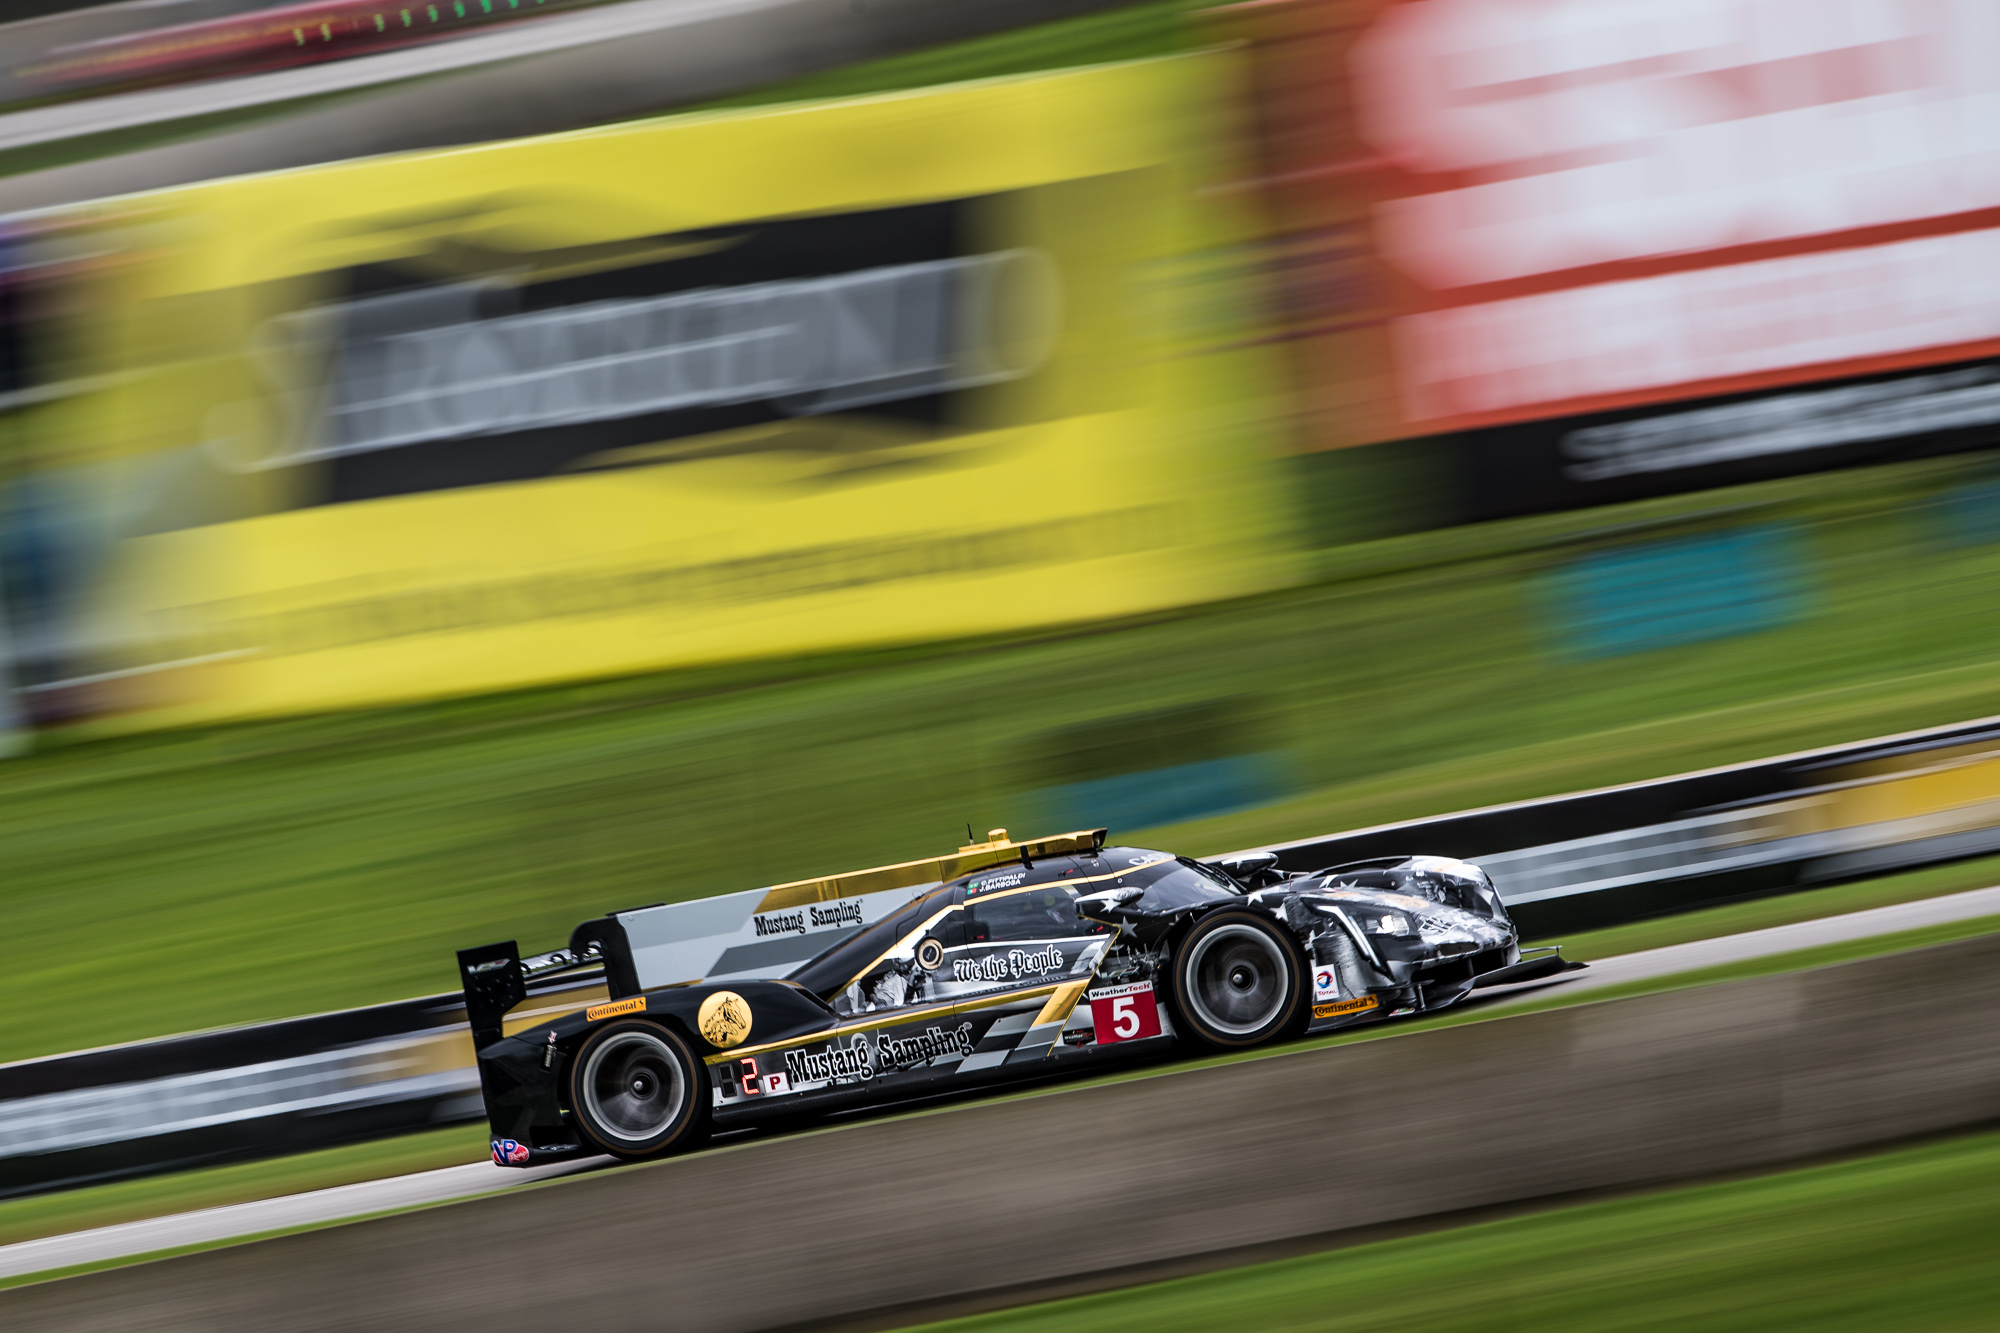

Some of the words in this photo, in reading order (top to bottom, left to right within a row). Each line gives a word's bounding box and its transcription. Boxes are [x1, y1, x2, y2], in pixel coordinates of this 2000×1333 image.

[753, 910, 806, 937] Mustang
[810, 900, 863, 928] Sampling
[953, 958, 982, 983] We
[981, 954, 1008, 981] the
[1008, 944, 1063, 978] People
[1092, 983, 1151, 997] WeatherTech
[588, 1000, 637, 1020] Continental
[1113, 996, 1140, 1038] 5
[1314, 999, 1368, 1017] Continental
[785, 1041, 873, 1084] Mustang
[877, 1026, 973, 1067] Sampling
[740, 1057, 760, 1095] 2
[769, 1075, 781, 1091] P
[491, 1139, 518, 1165] VP
